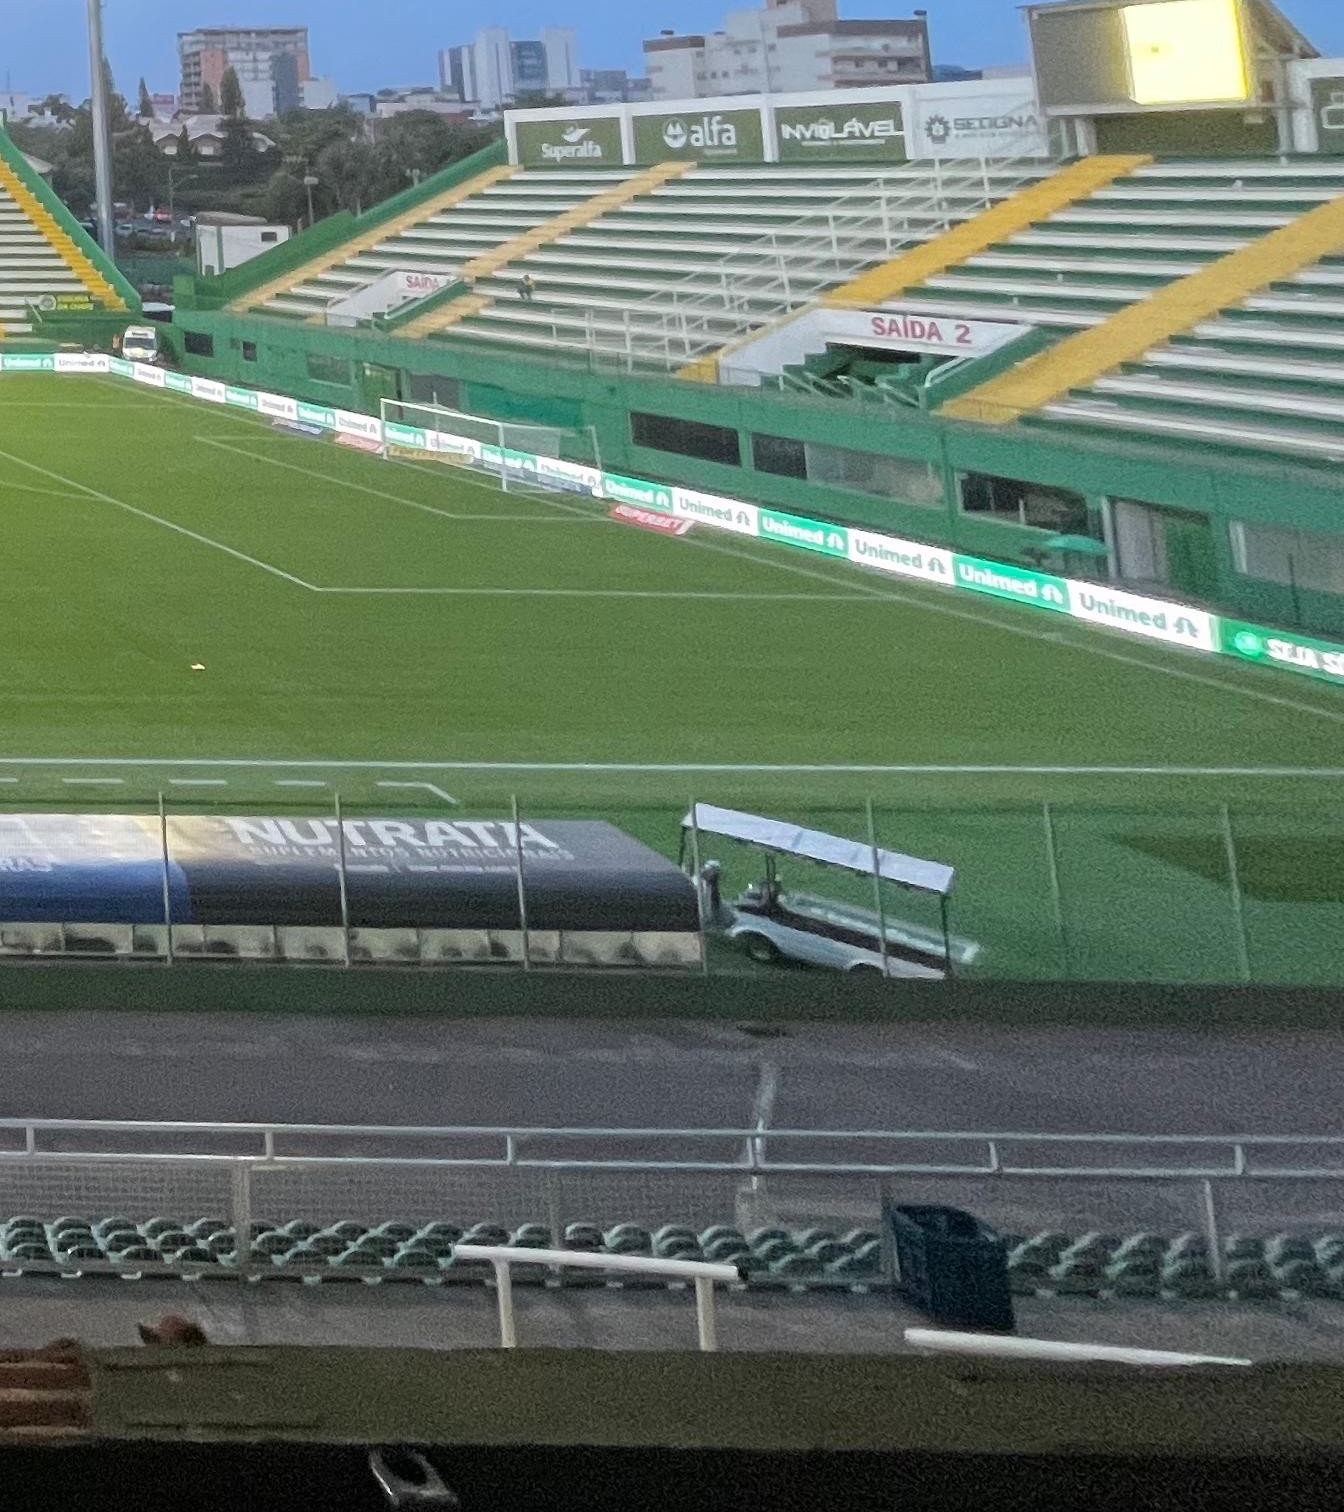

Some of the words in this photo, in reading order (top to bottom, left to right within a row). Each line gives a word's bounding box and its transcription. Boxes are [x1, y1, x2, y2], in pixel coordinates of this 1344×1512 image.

[690, 115, 736, 148] alfa
[870, 313, 944, 342] SAÍDA
[955, 323, 972, 344] 2
[58, 358, 95, 368] Unimed
[679, 496, 732, 522] Unimed
[762, 515, 824, 545] Unimed
[854, 538, 923, 569] Unimed
[957, 562, 1037, 597] Unimed
[1079, 592, 1168, 630] Unimed
[226, 819, 560, 849] NUTRATA
